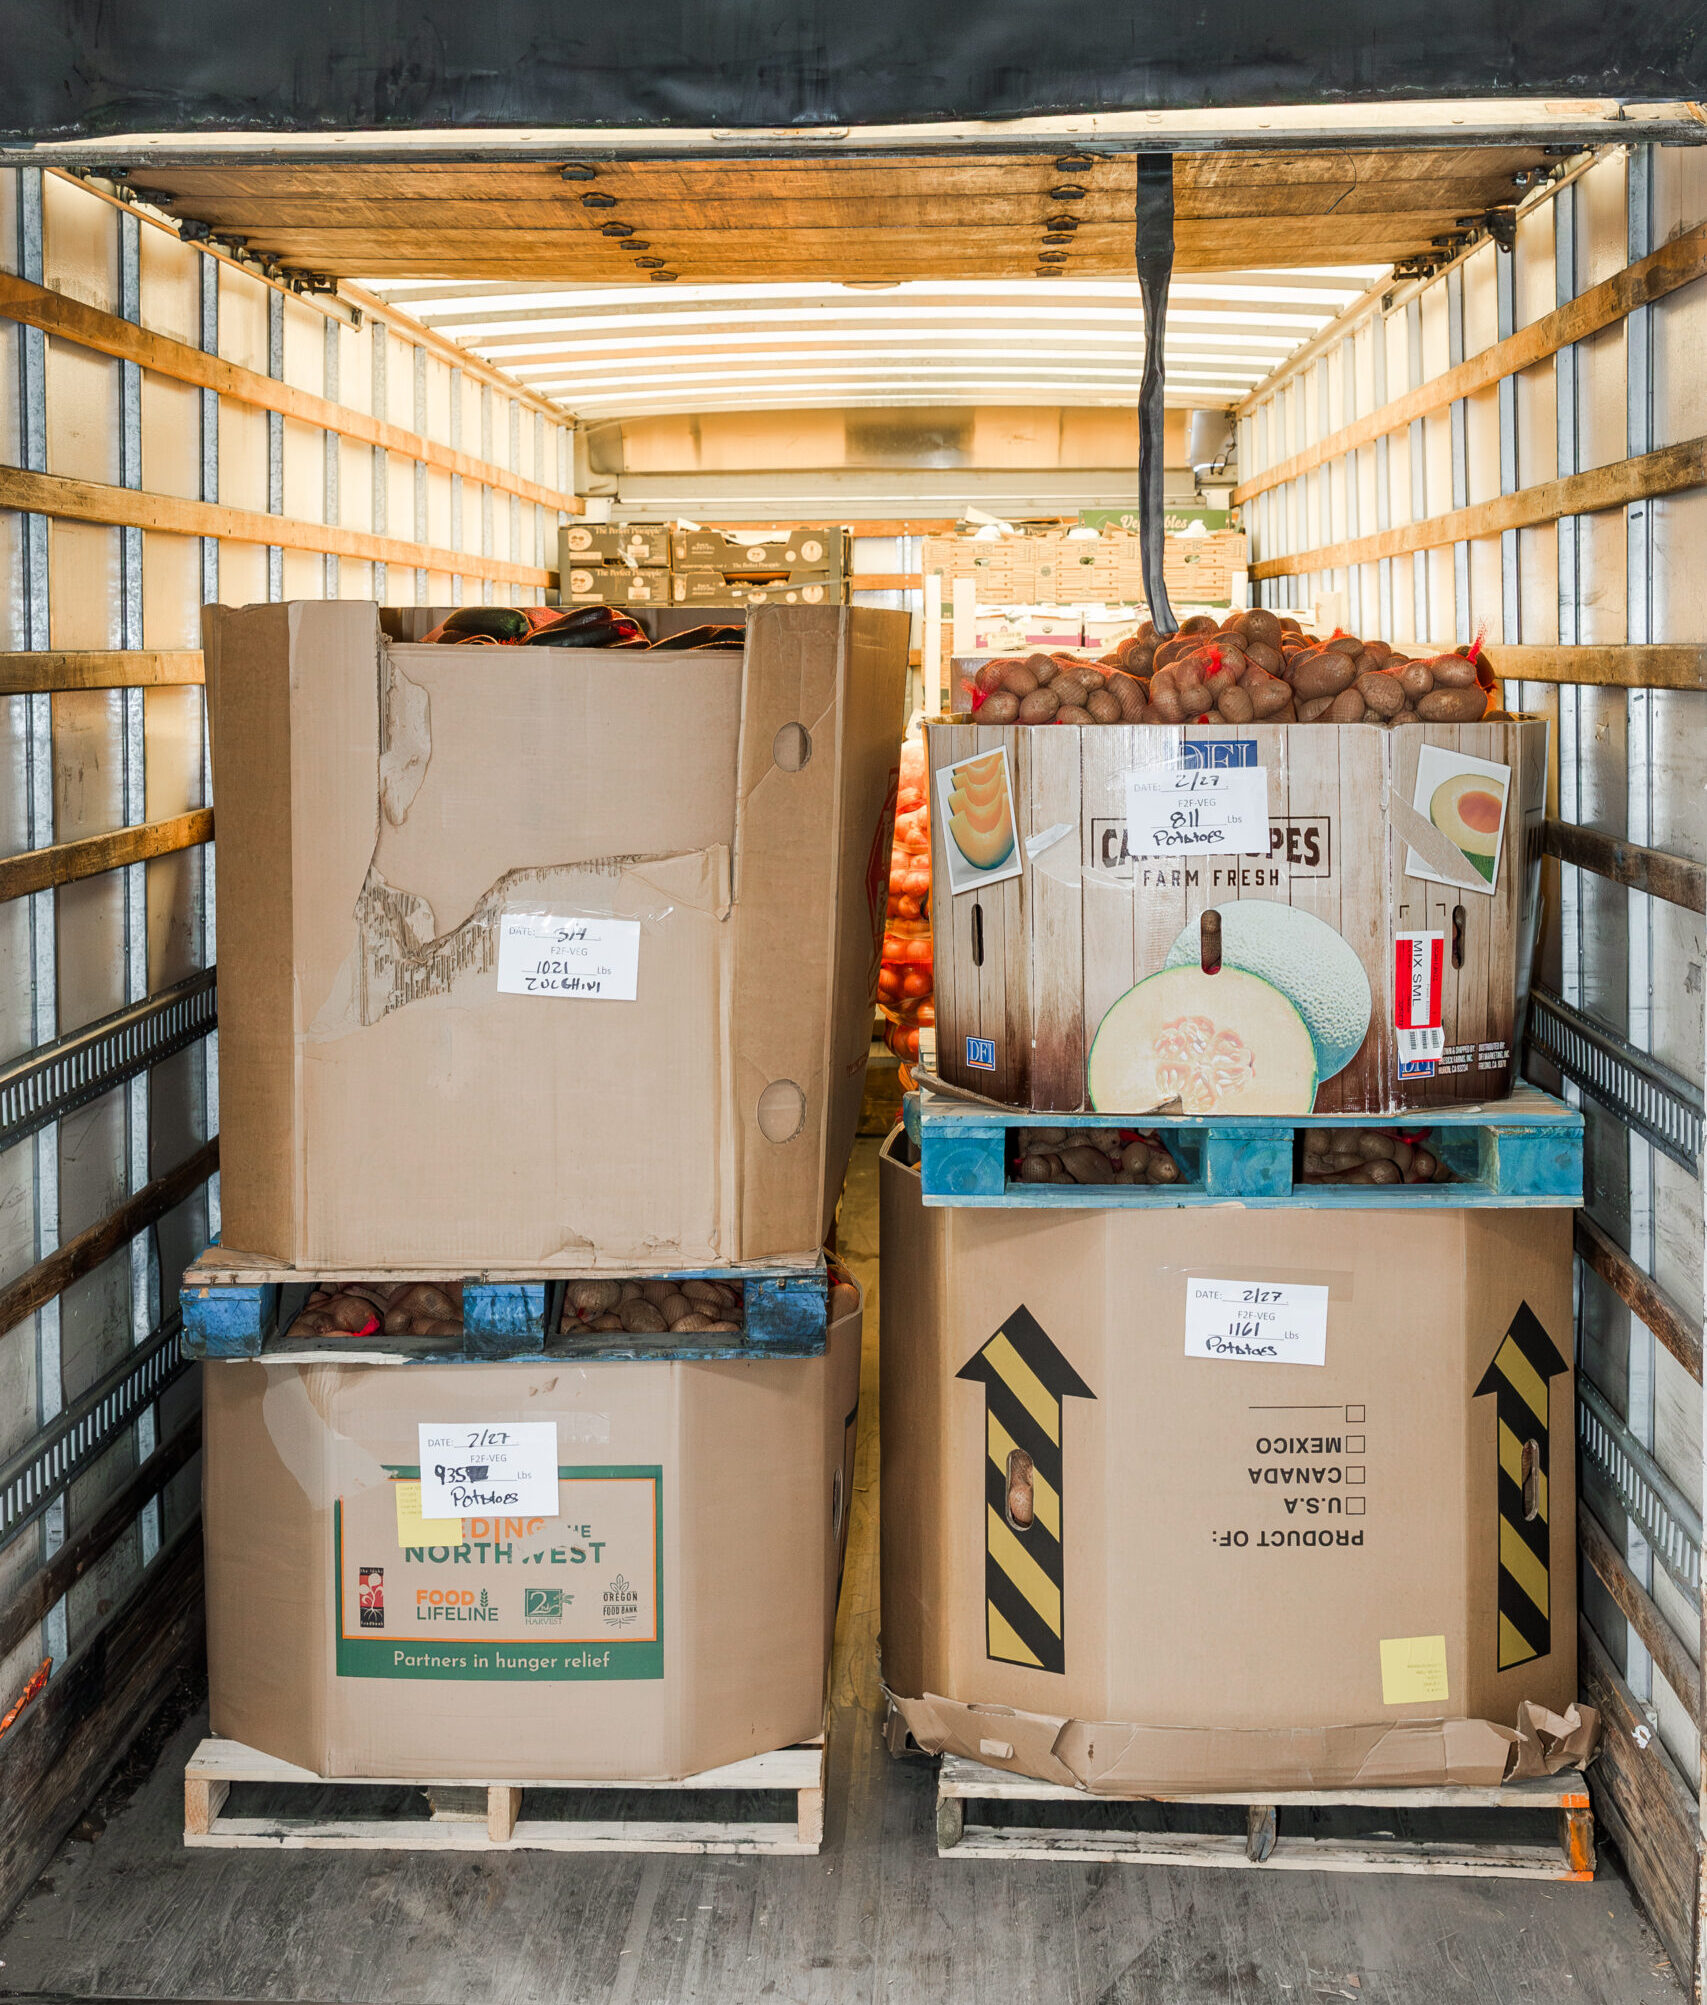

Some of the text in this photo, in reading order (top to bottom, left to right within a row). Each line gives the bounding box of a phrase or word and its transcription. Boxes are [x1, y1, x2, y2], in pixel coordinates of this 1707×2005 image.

[1120, 514, 1188, 529] Vebles
[1134, 772, 1220, 792] DATE: 2/27
[1178, 799, 1216, 808] F2F-VEG
[1170, 808, 1242, 829] 811 Lbs
[1143, 868, 1279, 888] FARM FRESH
[508, 926, 535, 936] DATE:
[550, 946, 588, 957] F2F-VEG
[536, 960, 569, 975] 1021
[1411, 940, 1423, 1008] MIX SML
[969, 1040, 993, 1064] DFI
[1195, 1288, 1283, 1303] DATE: 2/27
[1237, 1310, 1276, 1321] F2F-VEG
[1229, 1322, 1299, 1340] 1161 Lbs
[427, 1438, 454, 1448] DATE:
[1256, 1437, 1342, 1455] MEXICO
[470, 1454, 507, 1463] F2F-VEG
[517, 1471, 532, 1480] Lbs
[1248, 1467, 1342, 1485] CANADA
[1283, 1497, 1342, 1514] U.S.A
[1212, 1529, 1364, 1547] PRODUCT OF:
[416, 1589, 475, 1606] FOOD
[603, 1592, 638, 1602] OREGON
[417, 1606, 499, 1622] LIFELINE
[603, 1606, 638, 1616] FOOD BANK
[525, 1617, 563, 1626] HARVEST
[393, 1650, 611, 1672] Partners in hunger relief
